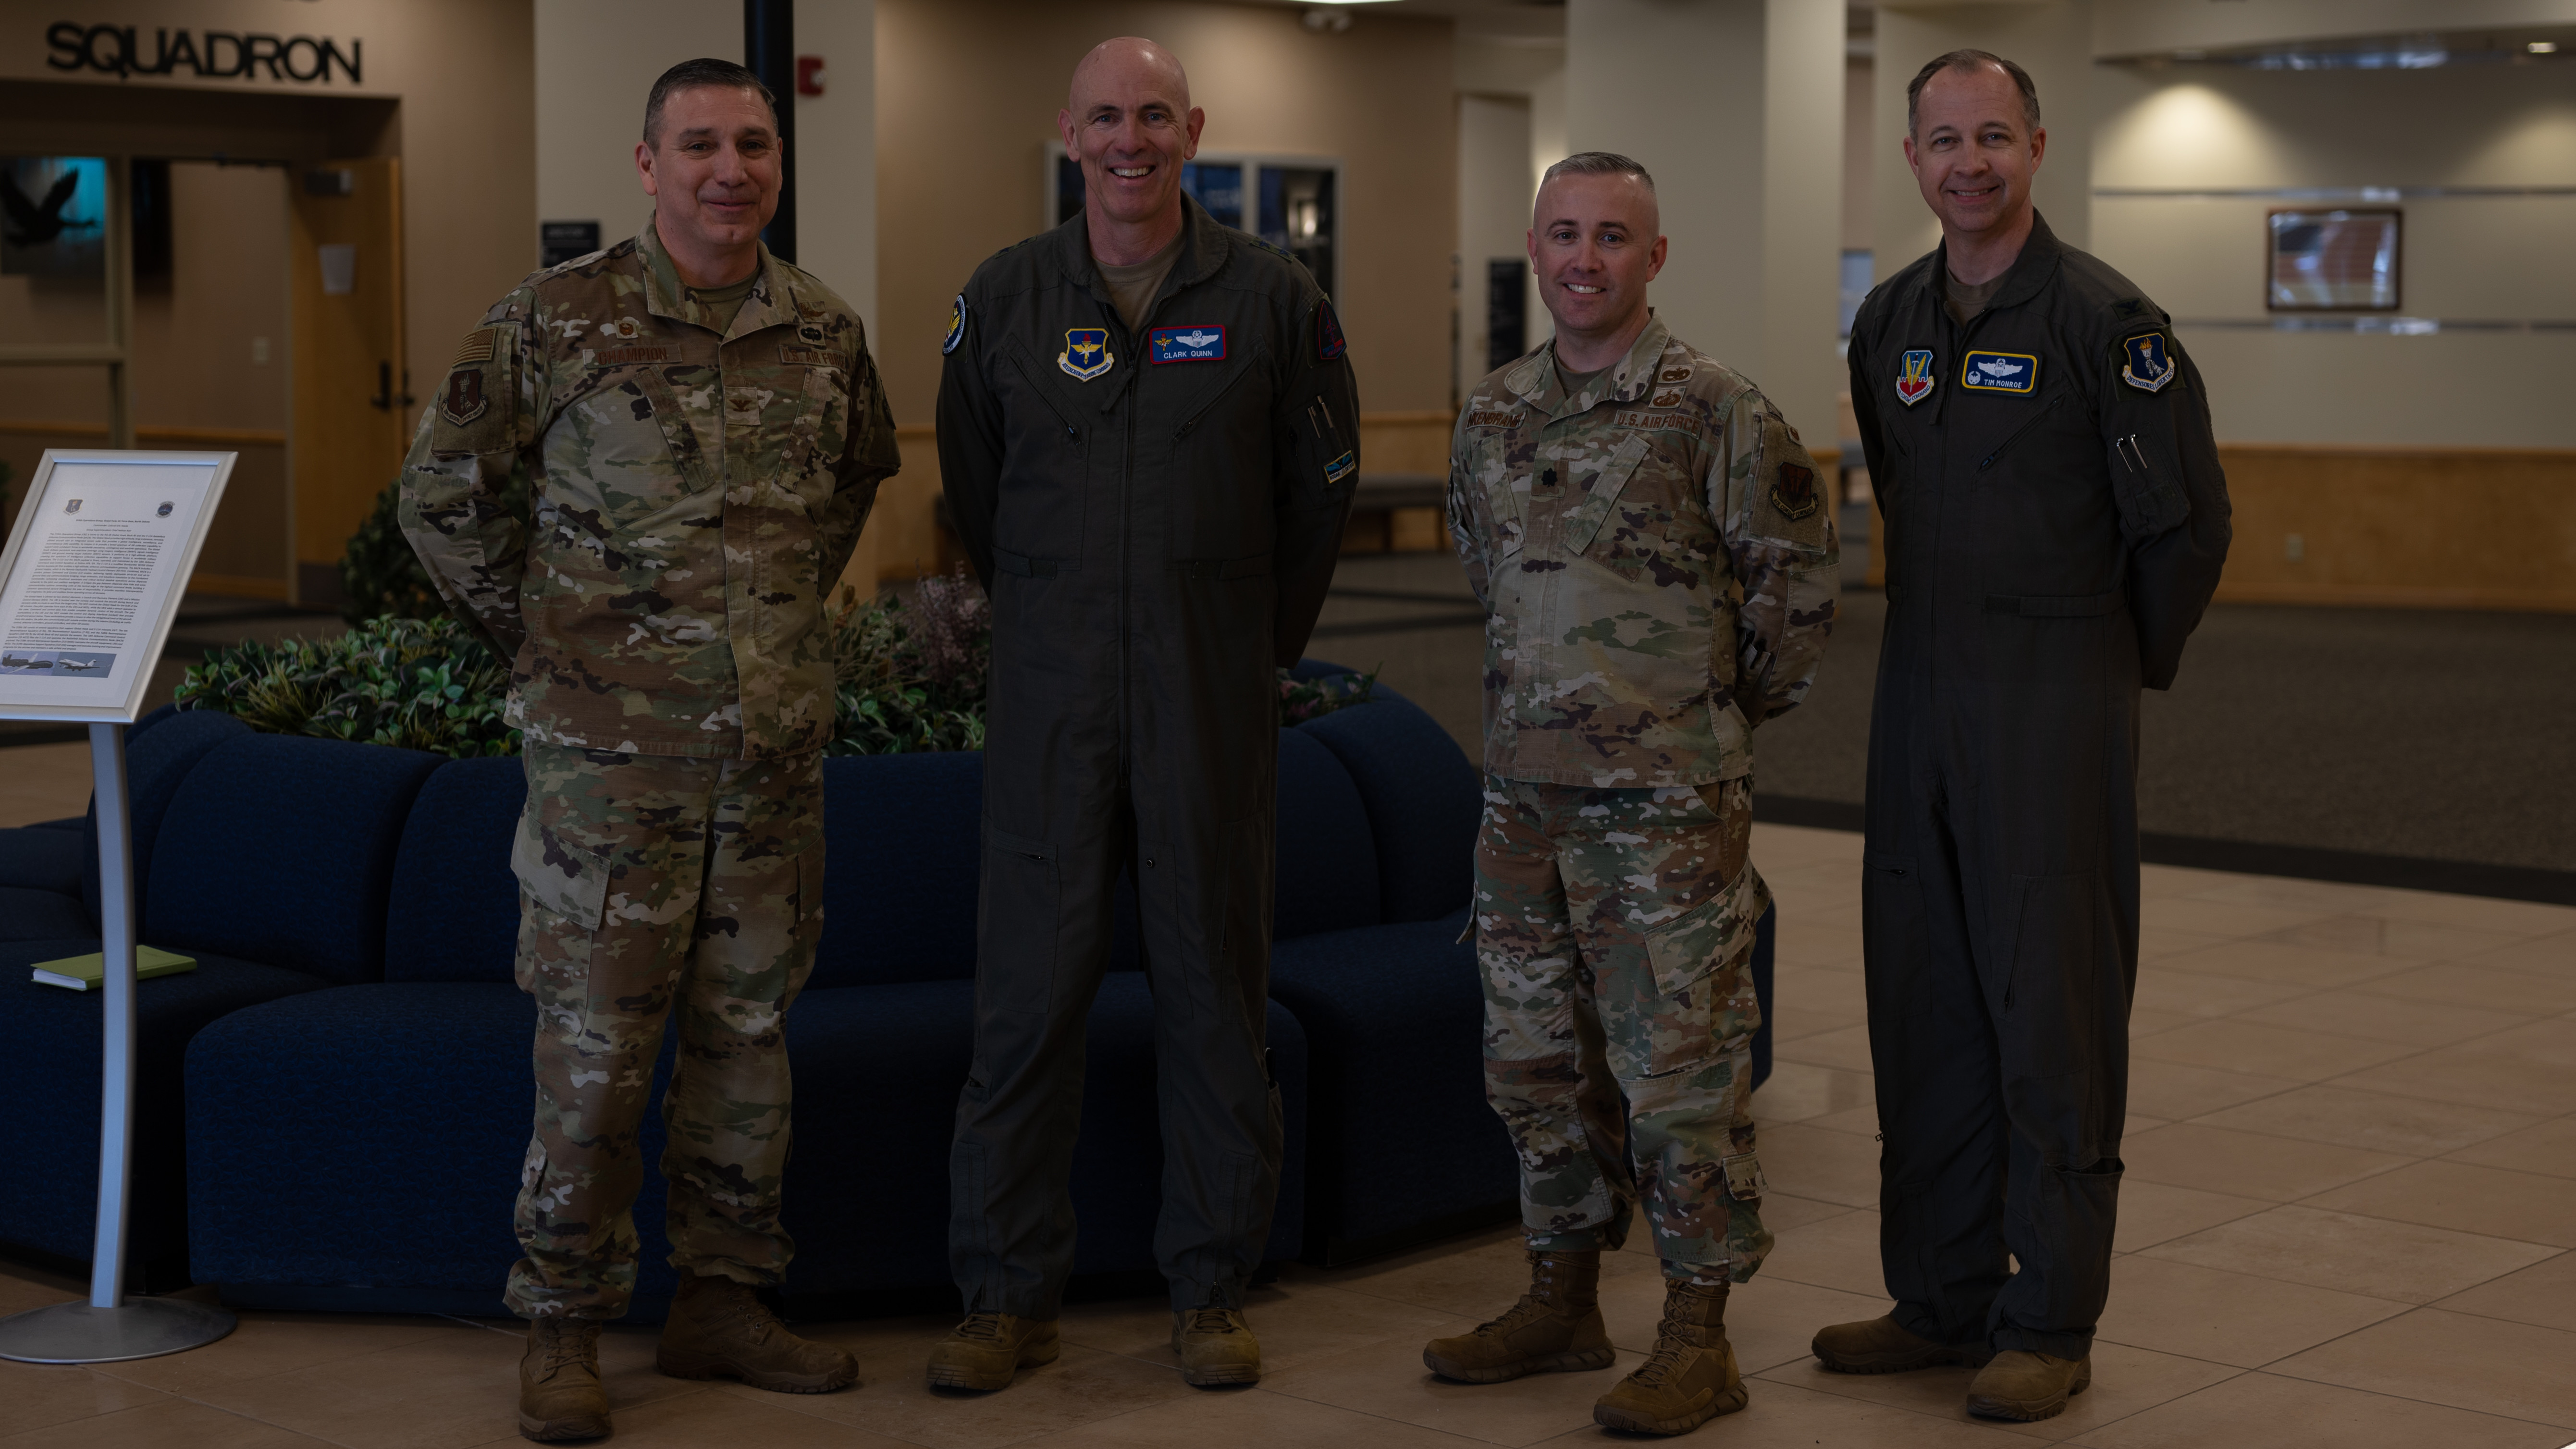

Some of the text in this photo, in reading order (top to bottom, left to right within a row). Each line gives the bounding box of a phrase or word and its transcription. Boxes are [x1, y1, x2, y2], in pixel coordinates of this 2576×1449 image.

[47, 21, 362, 83] SQUADRON
[597, 347, 668, 365] CHAMPION
[782, 348, 802, 362] U.S.
[806, 349, 821, 364] AIR
[1996, 380, 2022, 388] MONROE
[2127, 367, 2174, 390] DEFENSORES LIBERTATIS
[1912, 385, 1930, 400] COMMAND
[1617, 413, 1700, 434] U.S. AIR FORCE
[1796, 506, 1814, 516] COMMAND
